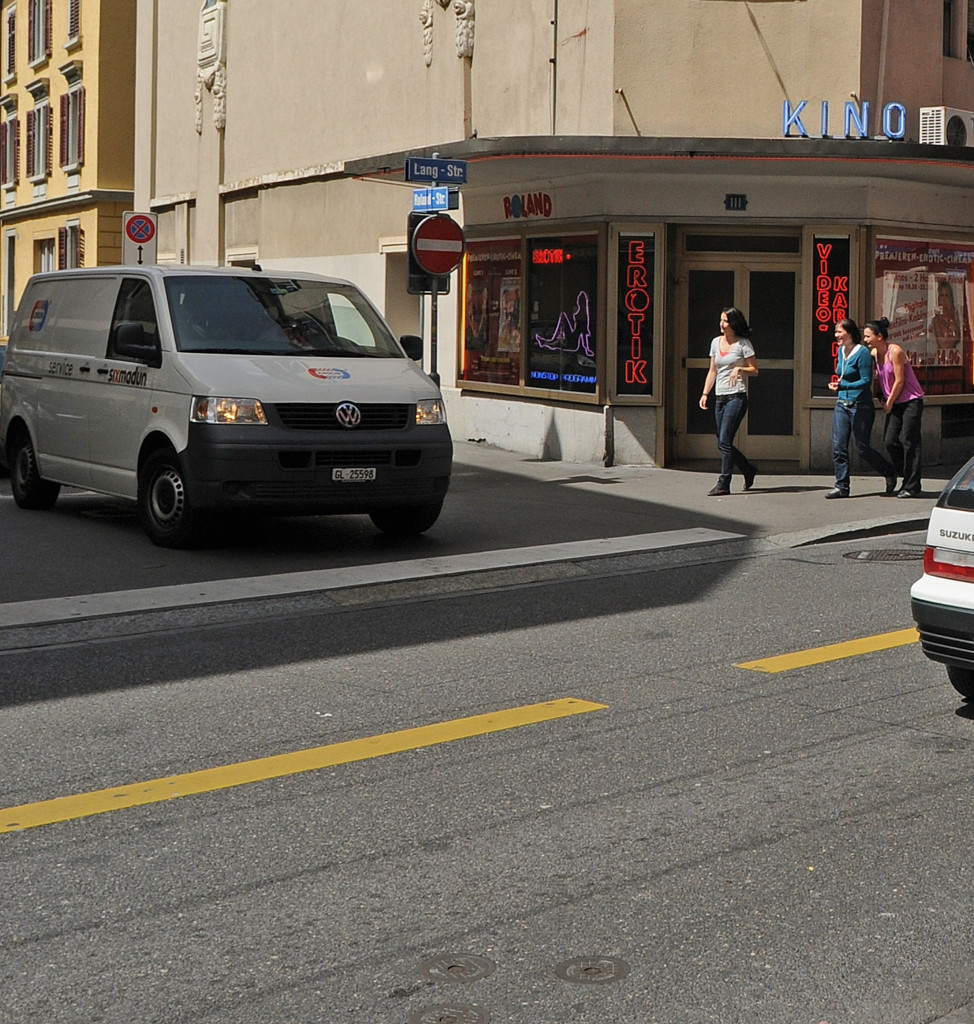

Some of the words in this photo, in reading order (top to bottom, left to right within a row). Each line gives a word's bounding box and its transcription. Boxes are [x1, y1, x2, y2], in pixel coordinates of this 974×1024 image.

[783, 100, 906, 139] KINO
[413, 163, 438, 178] Lang
[447, 164, 463, 177] Str.
[503, 192, 552, 219] ROLAND
[625, 241, 649, 384] EROTIK
[48, 358, 73, 376] service
[108, 366, 147, 386] sixmadun
[349, 469, 374, 479] 25598
[939, 529, 974, 542] SUZUKI
